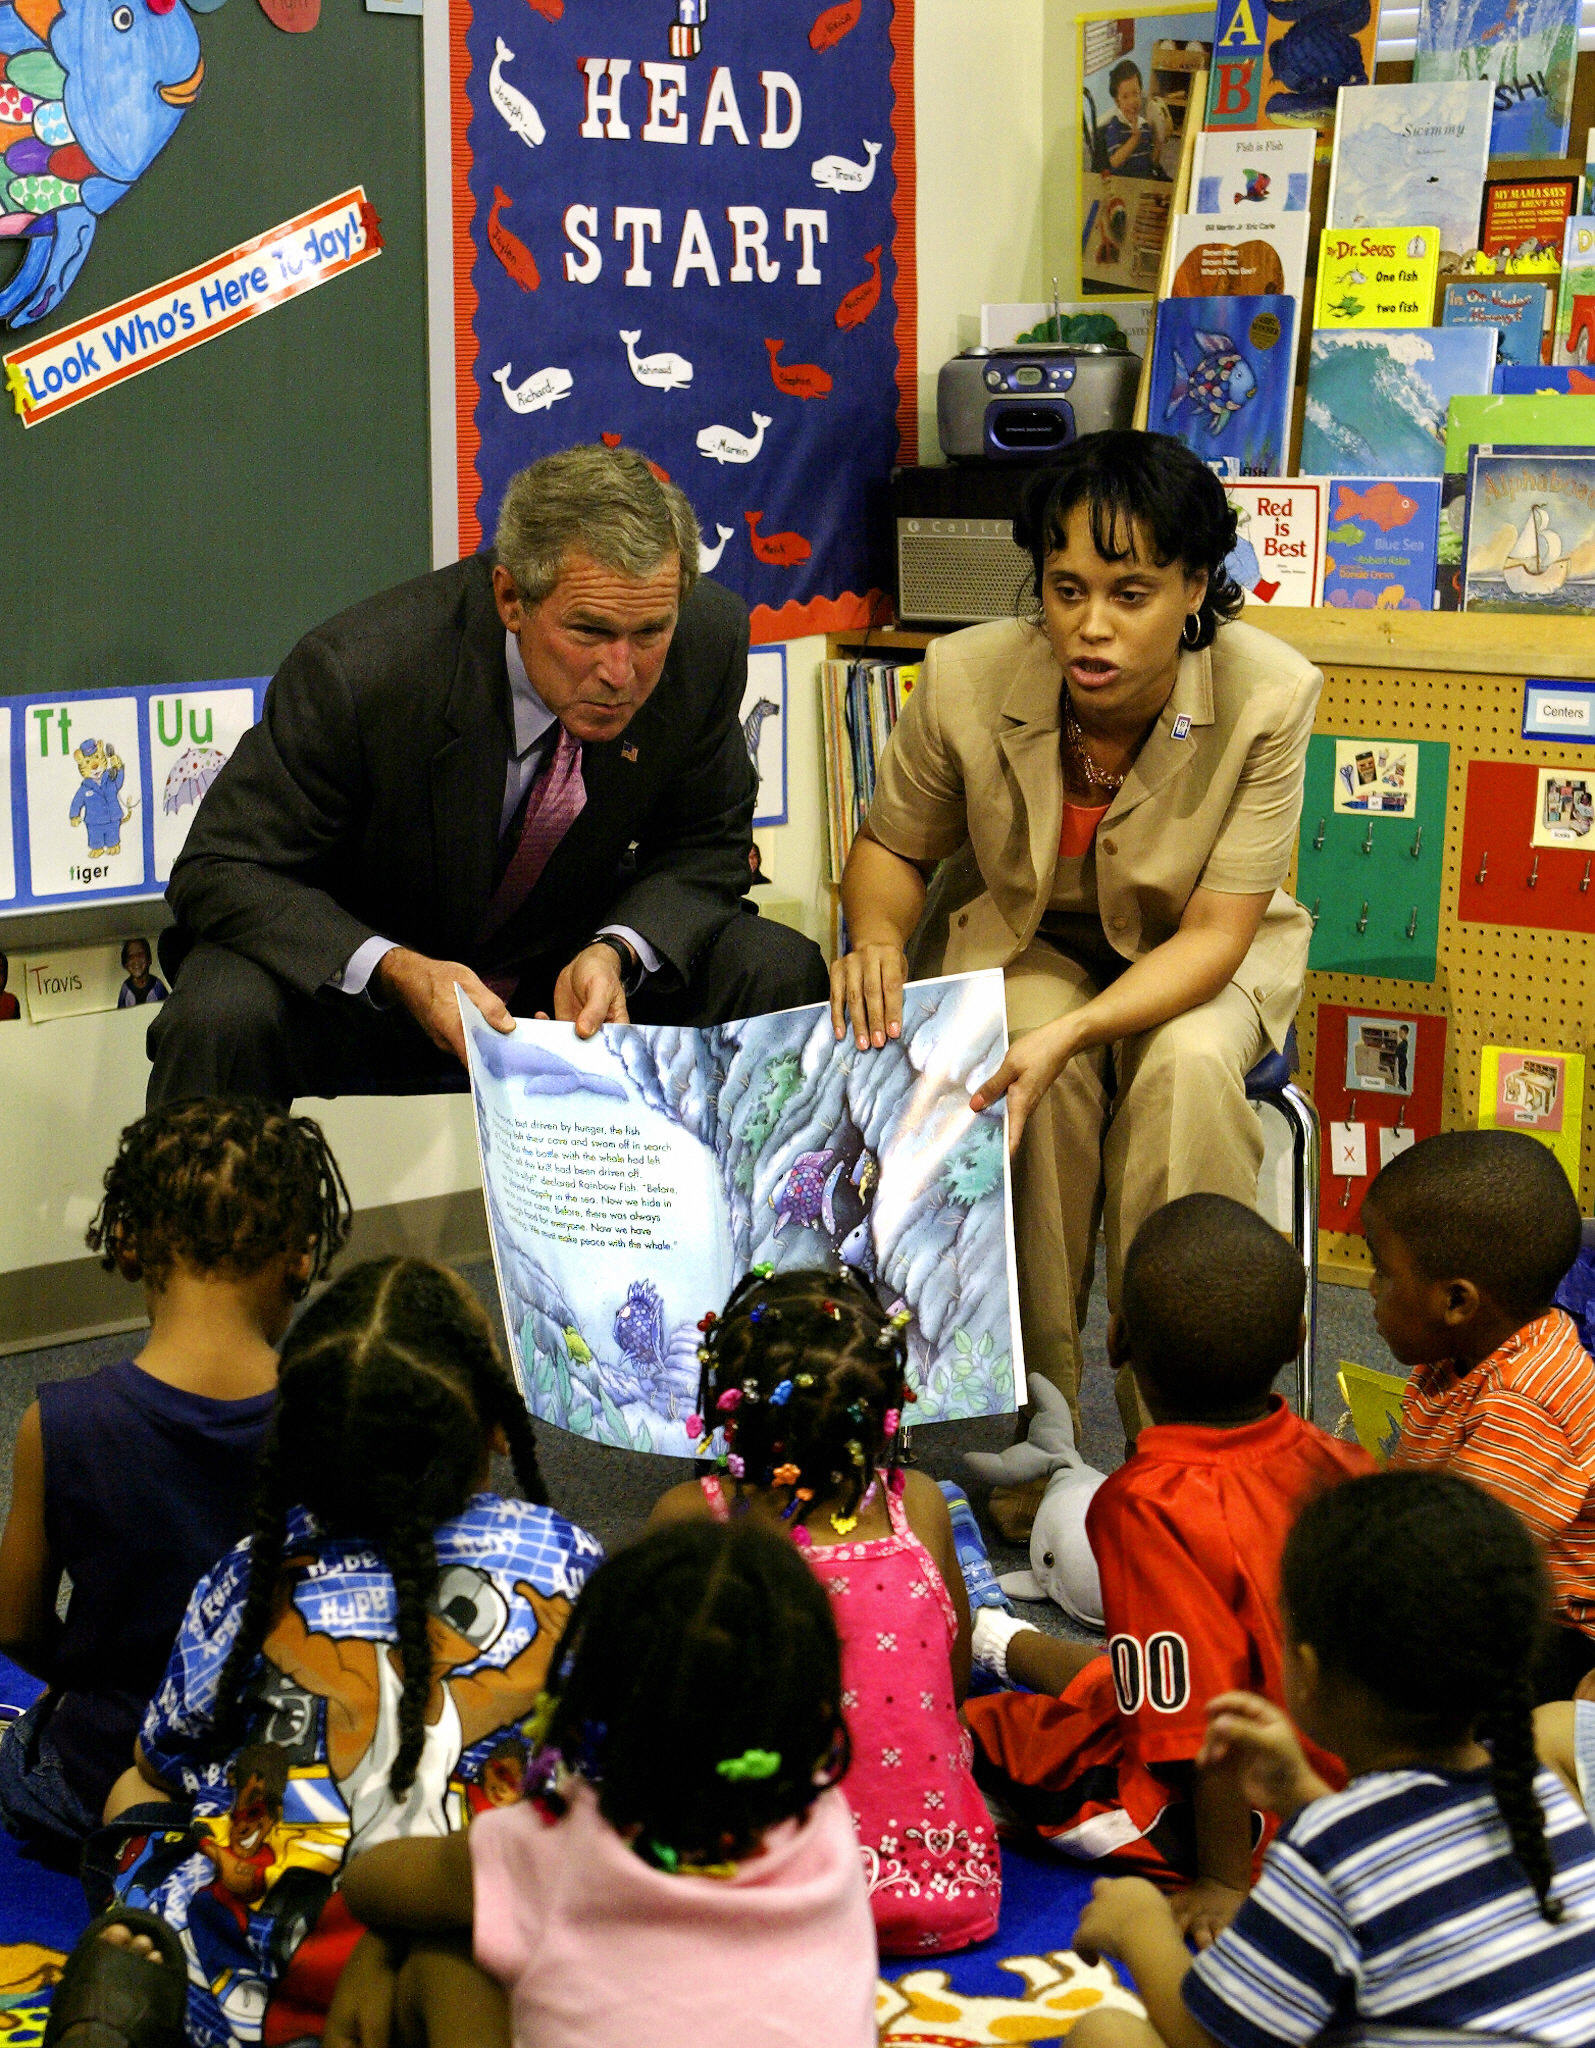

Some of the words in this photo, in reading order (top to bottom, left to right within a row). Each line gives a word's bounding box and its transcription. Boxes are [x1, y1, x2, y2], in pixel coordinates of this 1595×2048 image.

[1218, 0, 1261, 47] A
[1212, 60, 1255, 115] B
[578, 57, 803, 150] HEAD
[1402, 121, 1465, 138] Swimmy
[1236, 142, 1254, 153] Fish
[1256, 142, 1263, 152] is
[1265, 140, 1284, 151] Fish
[832, 166, 862, 182] Travis
[1495, 189, 1508, 200] MY
[1511, 187, 1542, 199] MAMA
[1542, 186, 1567, 198] SAYS
[1259, 222, 1275, 230] Carle
[563, 203, 828, 288] START
[1336, 241, 1358, 260] Dr.
[1359, 237, 1397, 258] Seuss
[1376, 271, 1395, 282] One
[1398, 270, 1419, 282] fish
[25, 340, 101, 402] Look
[103, 299, 194, 363] Who's
[199, 265, 270, 319] Here
[271, 210, 364, 362] Today!
[1377, 303, 1396, 313] two
[1399, 301, 1419, 313] fish
[1257, 498, 1293, 517] Red
[1274, 518, 1290, 537] is
[1264, 538, 1307, 558] Best
[1374, 538, 1399, 551] Blue
[1402, 538, 1424, 551] Sea
[1543, 704, 1584, 718] Centers
[157, 698, 213, 747] Uu
[33, 707, 73, 757] Tt
[69, 864, 109, 884] tiger
[29, 965, 83, 996] Travis
[531, 1120, 558, 1131] driven
[561, 1121, 572, 1134] by
[574, 1122, 607, 1136] hunger,
[609, 1125, 622, 1136] the
[625, 1125, 640, 1136] fish
[548, 1138, 568, 1146] cave
[571, 1136, 587, 1147] and
[591, 1140, 616, 1149] swam
[618, 1139, 630, 1149] off
[633, 1141, 640, 1149] in
[643, 1141, 672, 1152] search
[561, 1150, 581, 1161] with
[583, 1151, 596, 1161] the
[599, 1152, 625, 1163] whale
[627, 1153, 645, 1165] had
[647, 1154, 661, 1165] left
[555, 1162, 571, 1174] had
[573, 1164, 596, 1176] been
[598, 1165, 625, 1178] driven
[541, 1176, 576, 1189] declared
[578, 1180, 617, 1191] Rainbow
[555, 1193, 562, 1201] in
[565, 1192, 578, 1203] the
[580, 1195, 599, 1205] sea.
[601, 1195, 623, 1206] Now
[625, 1198, 639, 1207] we
[641, 1196, 661, 1208] hide
[663, 1198, 672, 1208] in
[585, 1207, 607, 1219] there
[610, 1211, 627, 1220] was
[629, 1210, 661, 1224] always
[590, 1222, 613, 1233] Now
[615, 1226, 628, 1234] we
[630, 1224, 652, 1236] have
[580, 1238, 606, 1248] peace
[608, 1237, 626, 1248] with
[628, 1238, 642, 1249] the
[1109, 1630, 1191, 1716] 00
